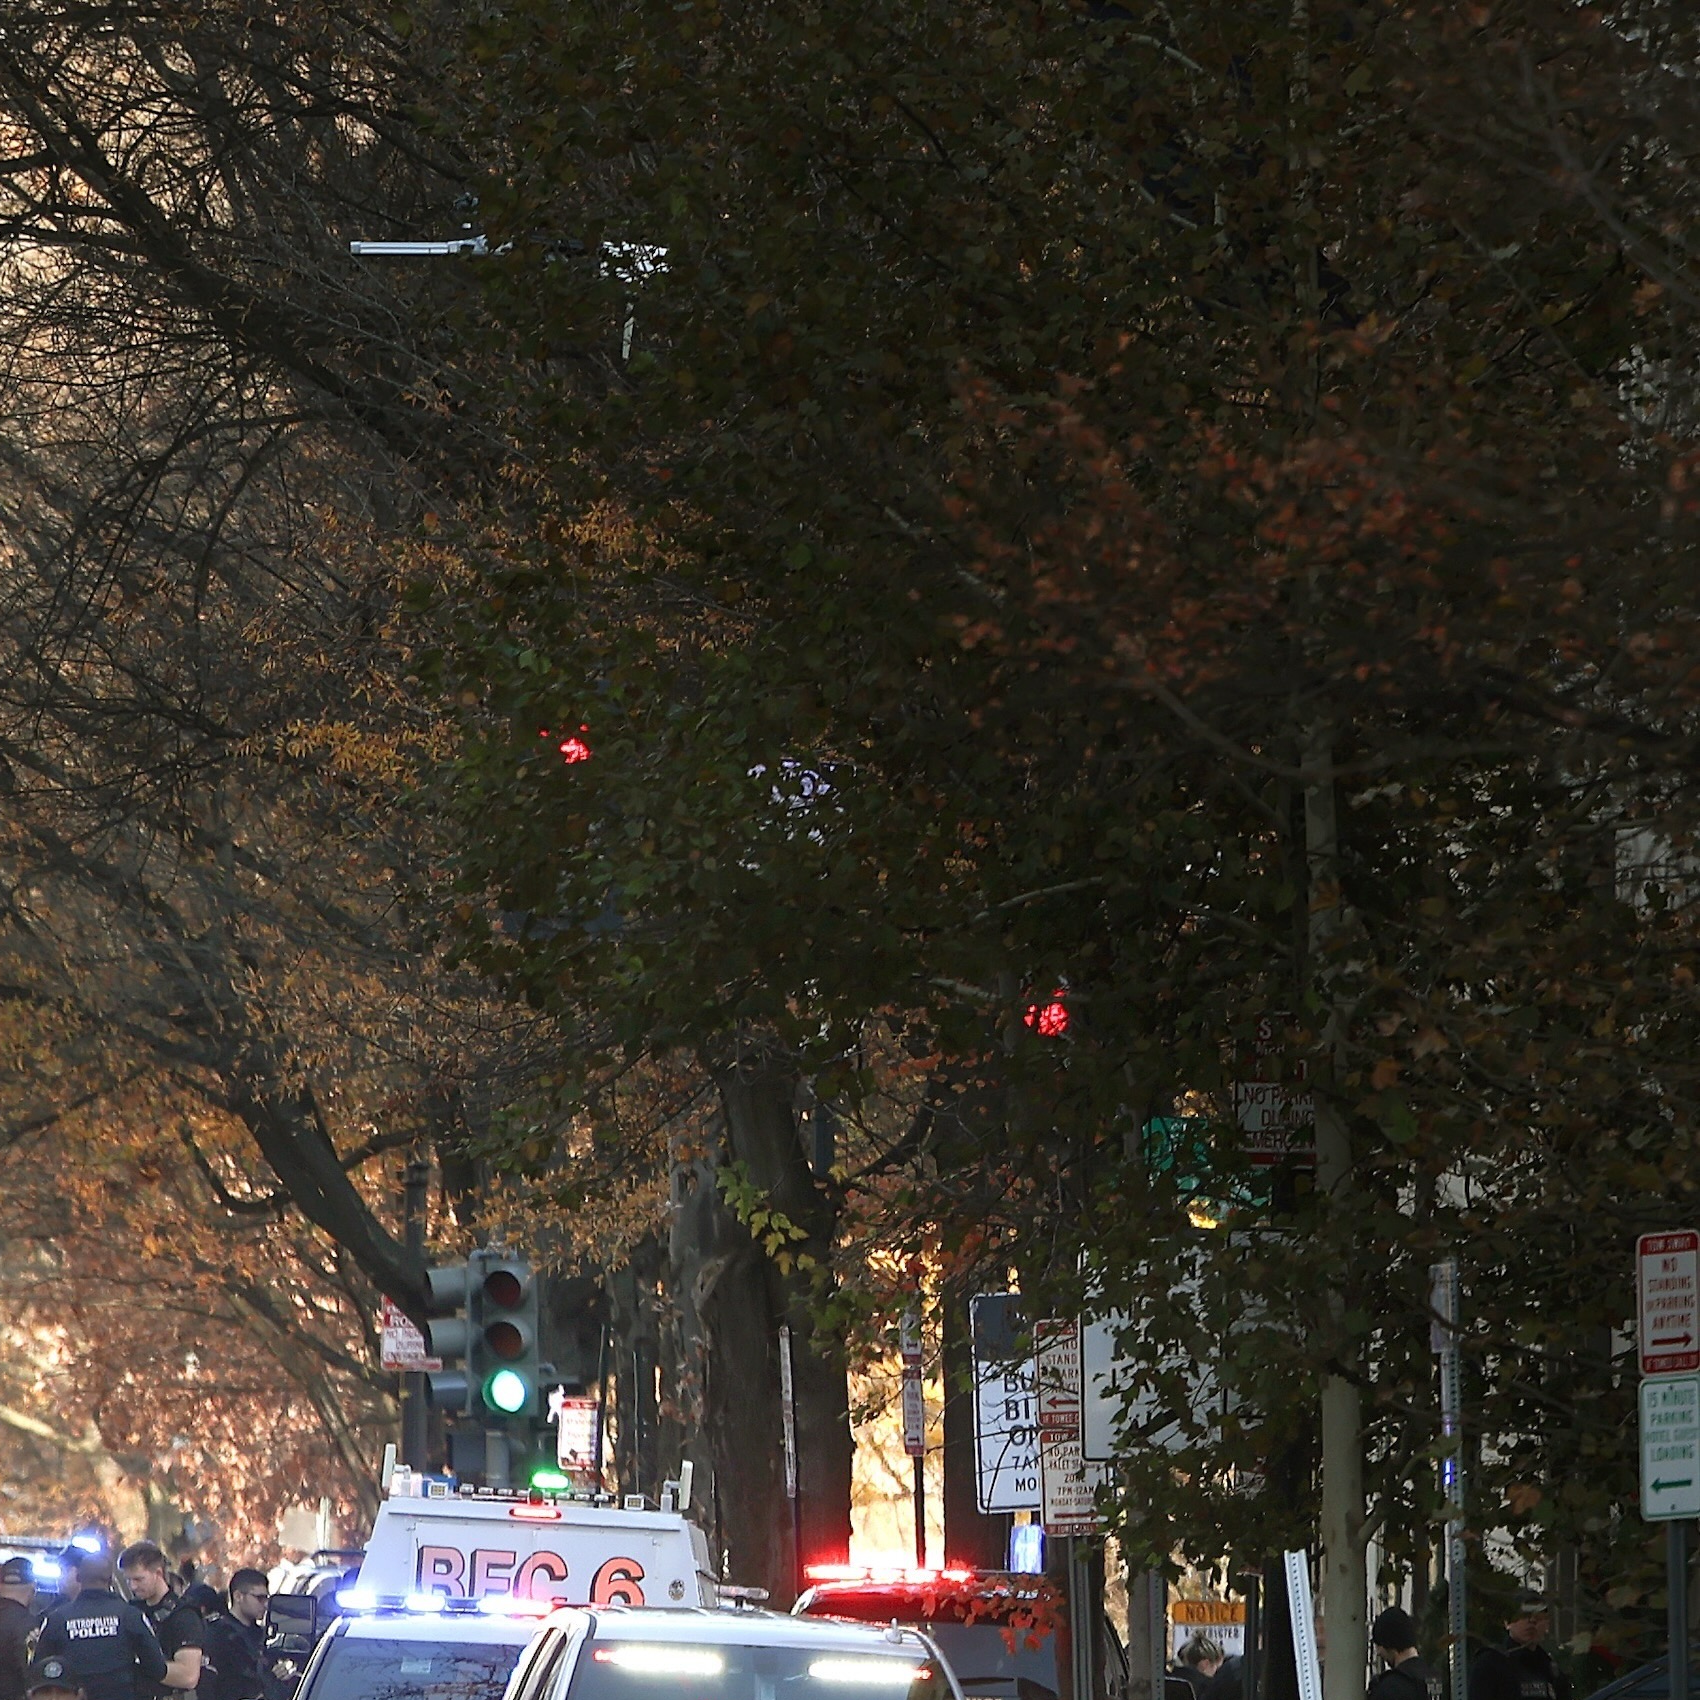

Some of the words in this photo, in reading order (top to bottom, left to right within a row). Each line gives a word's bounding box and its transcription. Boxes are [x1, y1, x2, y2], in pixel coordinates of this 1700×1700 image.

[1046, 1354, 1078, 1365] STAND
[590, 1557, 645, 1606] 6
[1185, 1603, 1238, 1622] NOTICE
[66, 1616, 120, 1631] METROPOLITAN
[69, 1627, 118, 1640] POLICE
